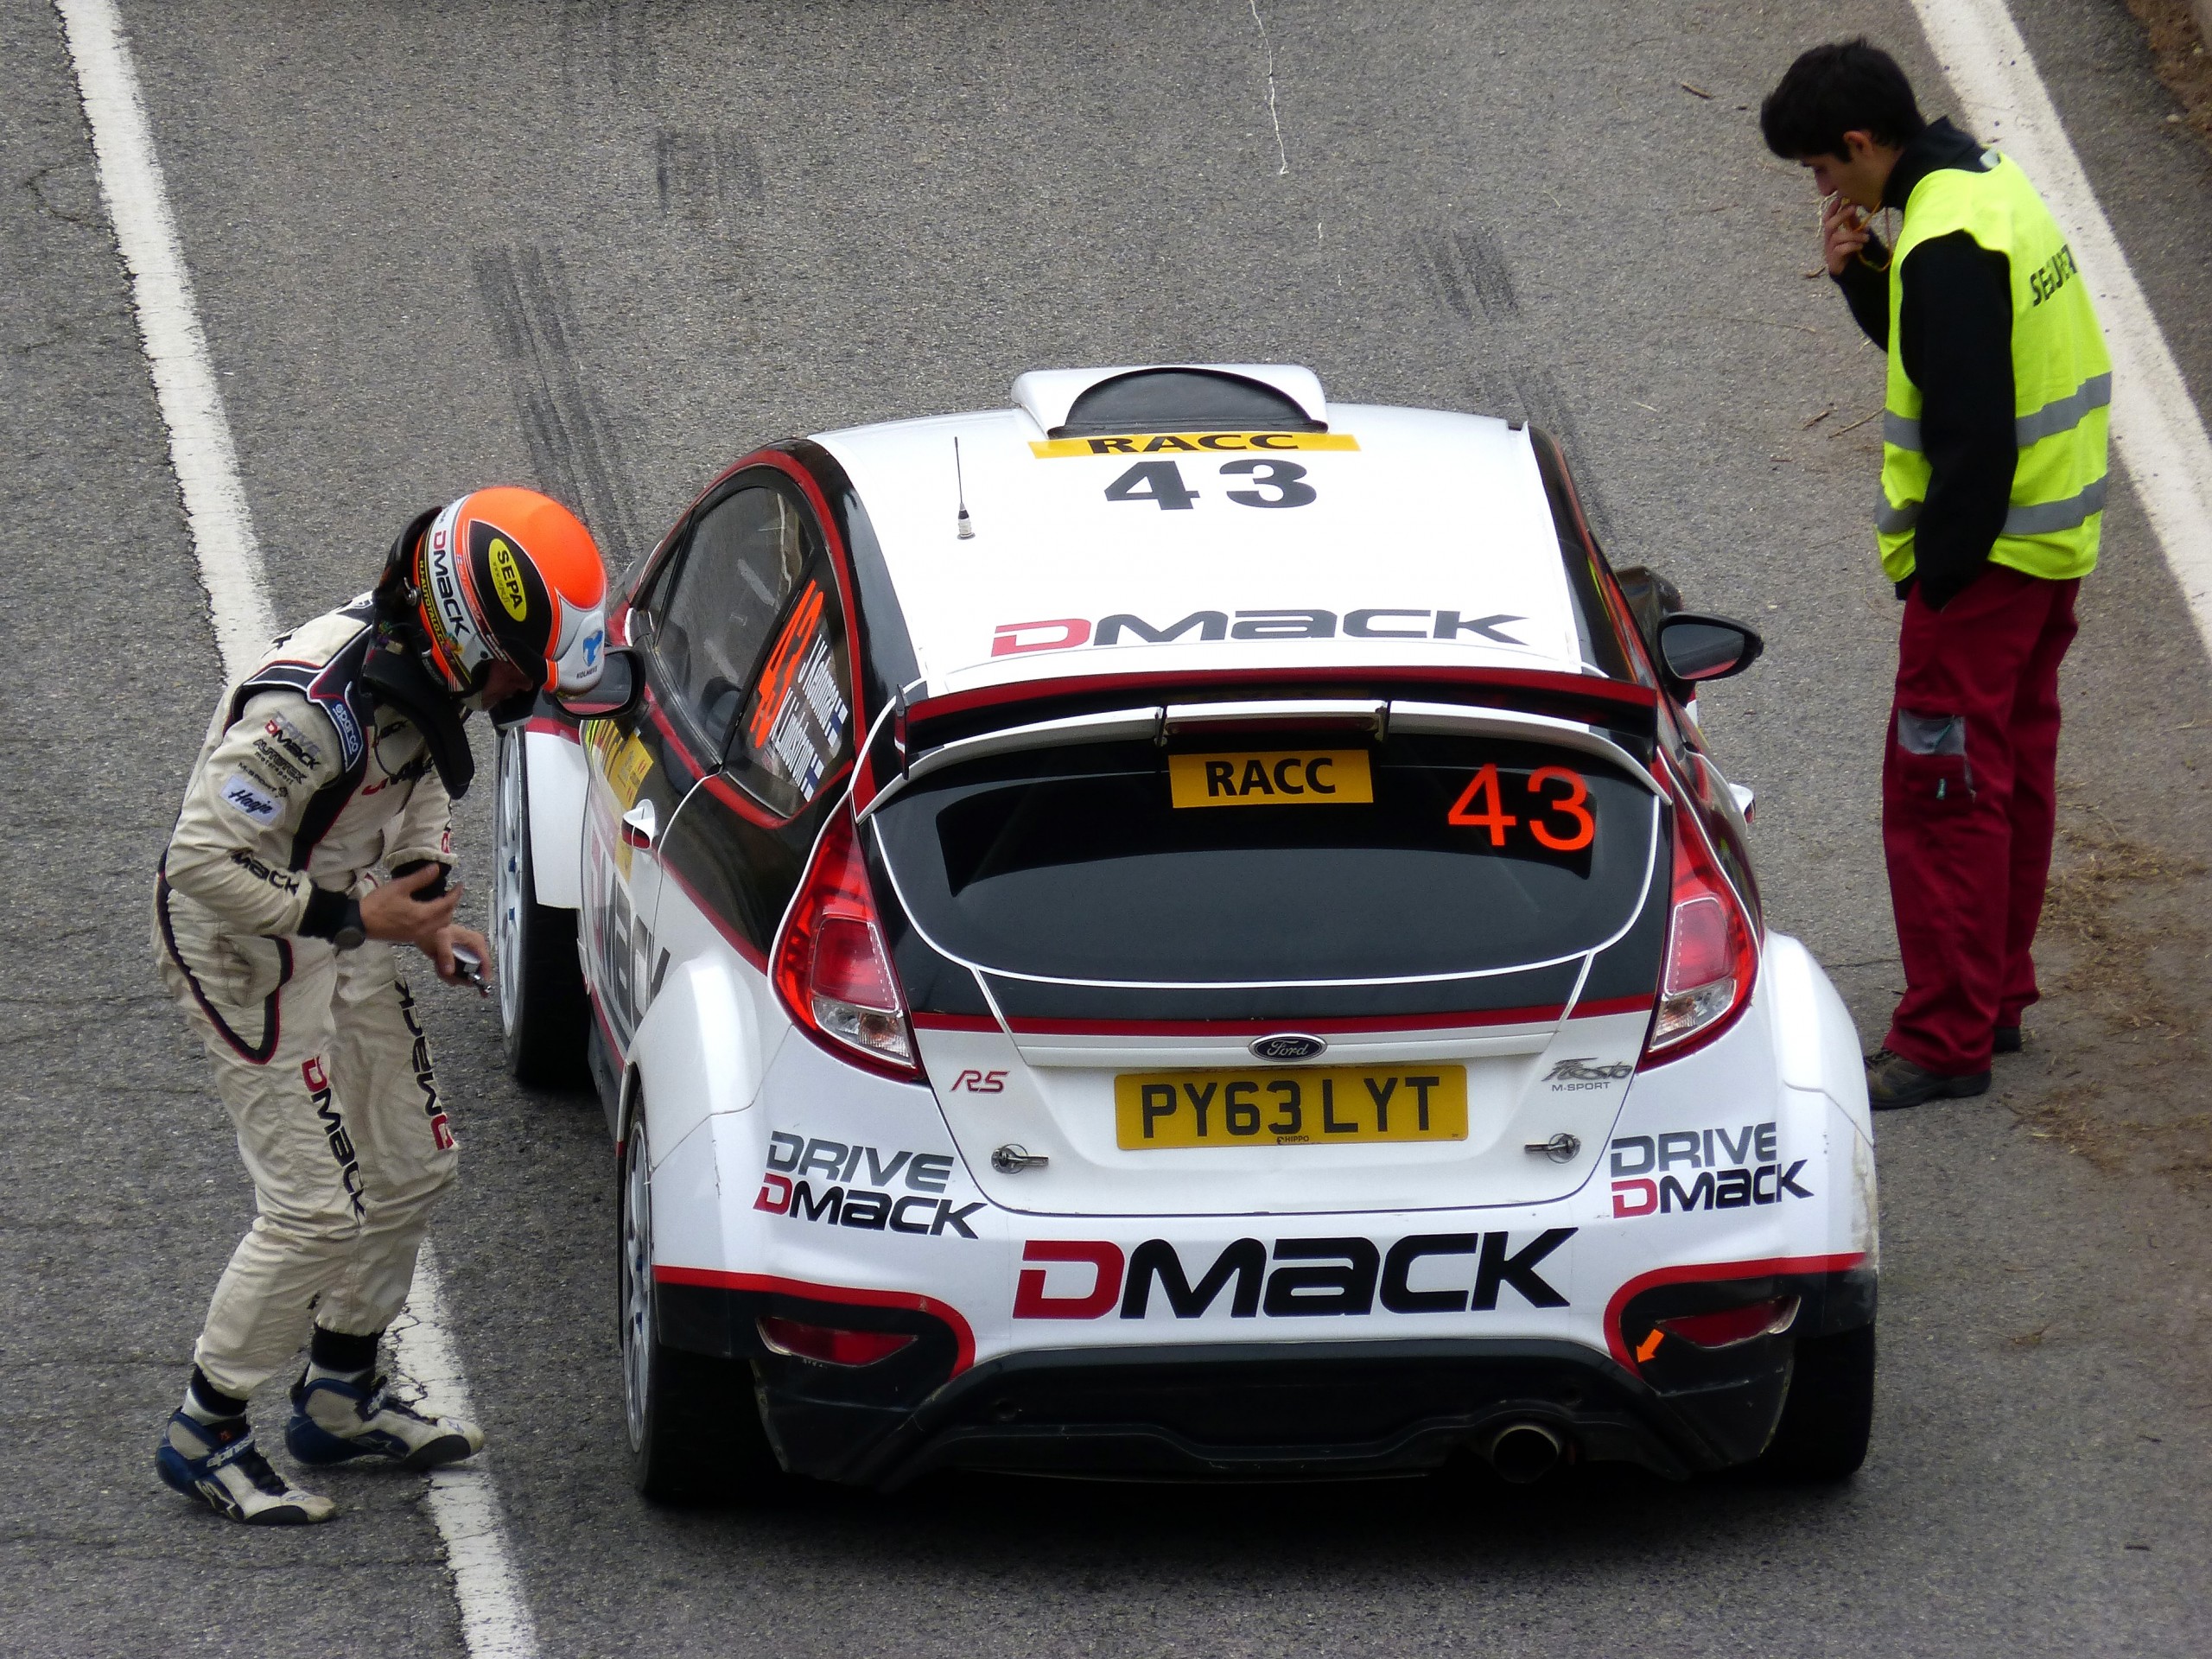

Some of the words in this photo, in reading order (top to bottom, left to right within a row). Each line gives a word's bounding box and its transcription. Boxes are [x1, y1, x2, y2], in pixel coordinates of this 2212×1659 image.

[1086, 434, 1300, 455] RACC
[1103, 458, 1318, 512] 43
[497, 550, 525, 611] SEPA
[334, 703, 359, 753] sparco
[1205, 757, 1337, 798] RACC
[1447, 762, 1596, 852] 43
[1267, 1039, 1308, 1057] Ford
[950, 1070, 1010, 1094] RS
[1141, 1080, 1303, 1139] PY63
[1322, 1076, 1440, 1134] LYT
[1552, 1082, 1611, 1092] M-SPORT
[767, 1130, 954, 1193] DRIVE
[1610, 1122, 1777, 1178] DRIVE
